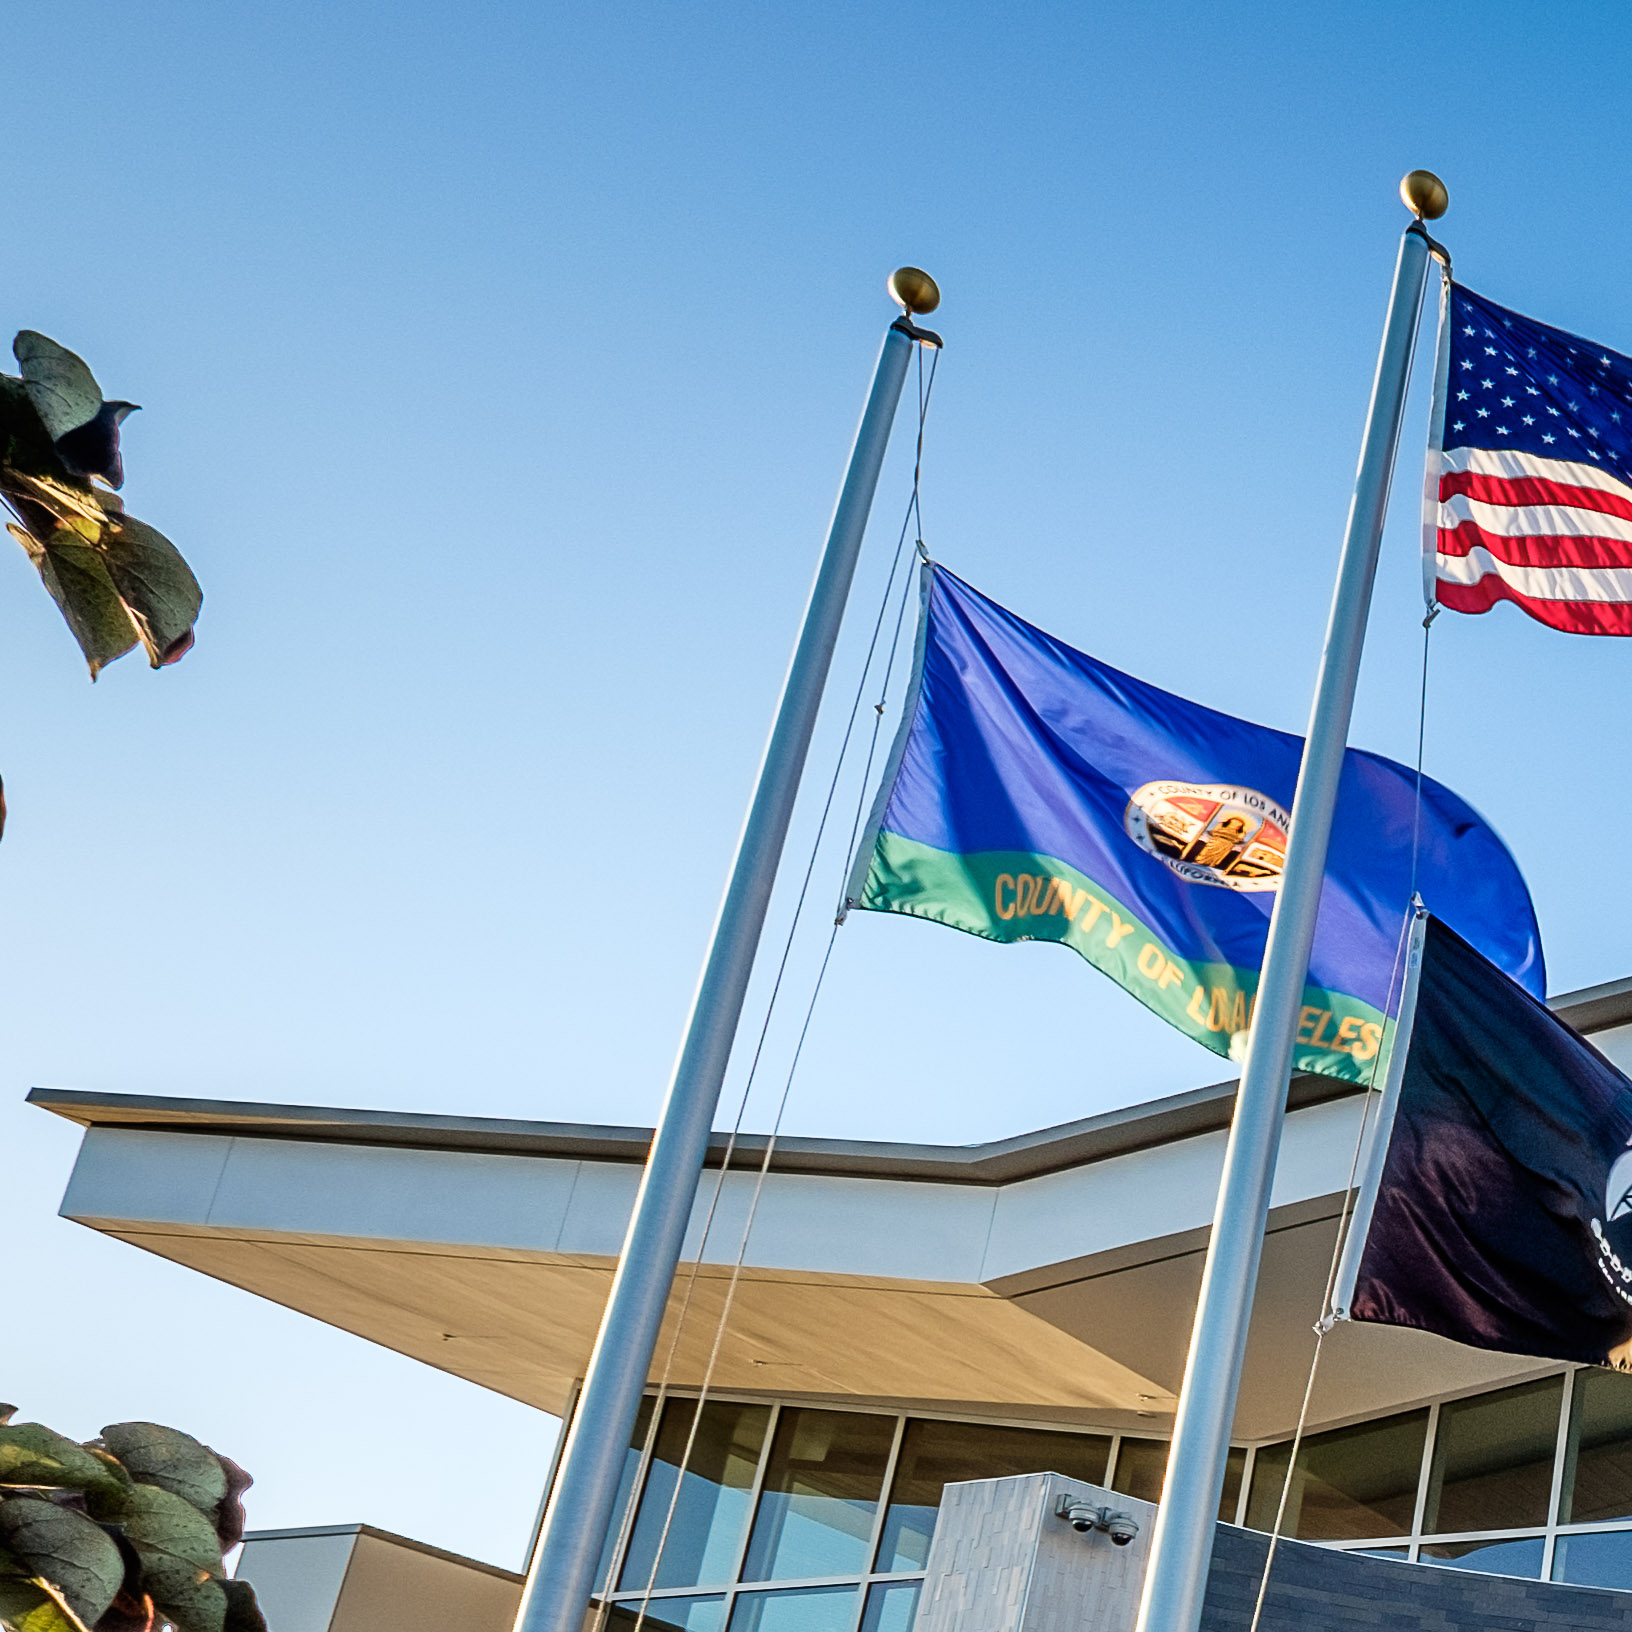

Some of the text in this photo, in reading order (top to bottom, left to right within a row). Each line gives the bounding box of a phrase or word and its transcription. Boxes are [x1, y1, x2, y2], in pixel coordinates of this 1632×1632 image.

[1219, 790, 1238, 801] OF
[1244, 793, 1266, 812] LOS
[995, 873, 1135, 949] COUNTY
[1136, 942, 1185, 991] OF
[1233, 990, 1384, 1061] AELES
